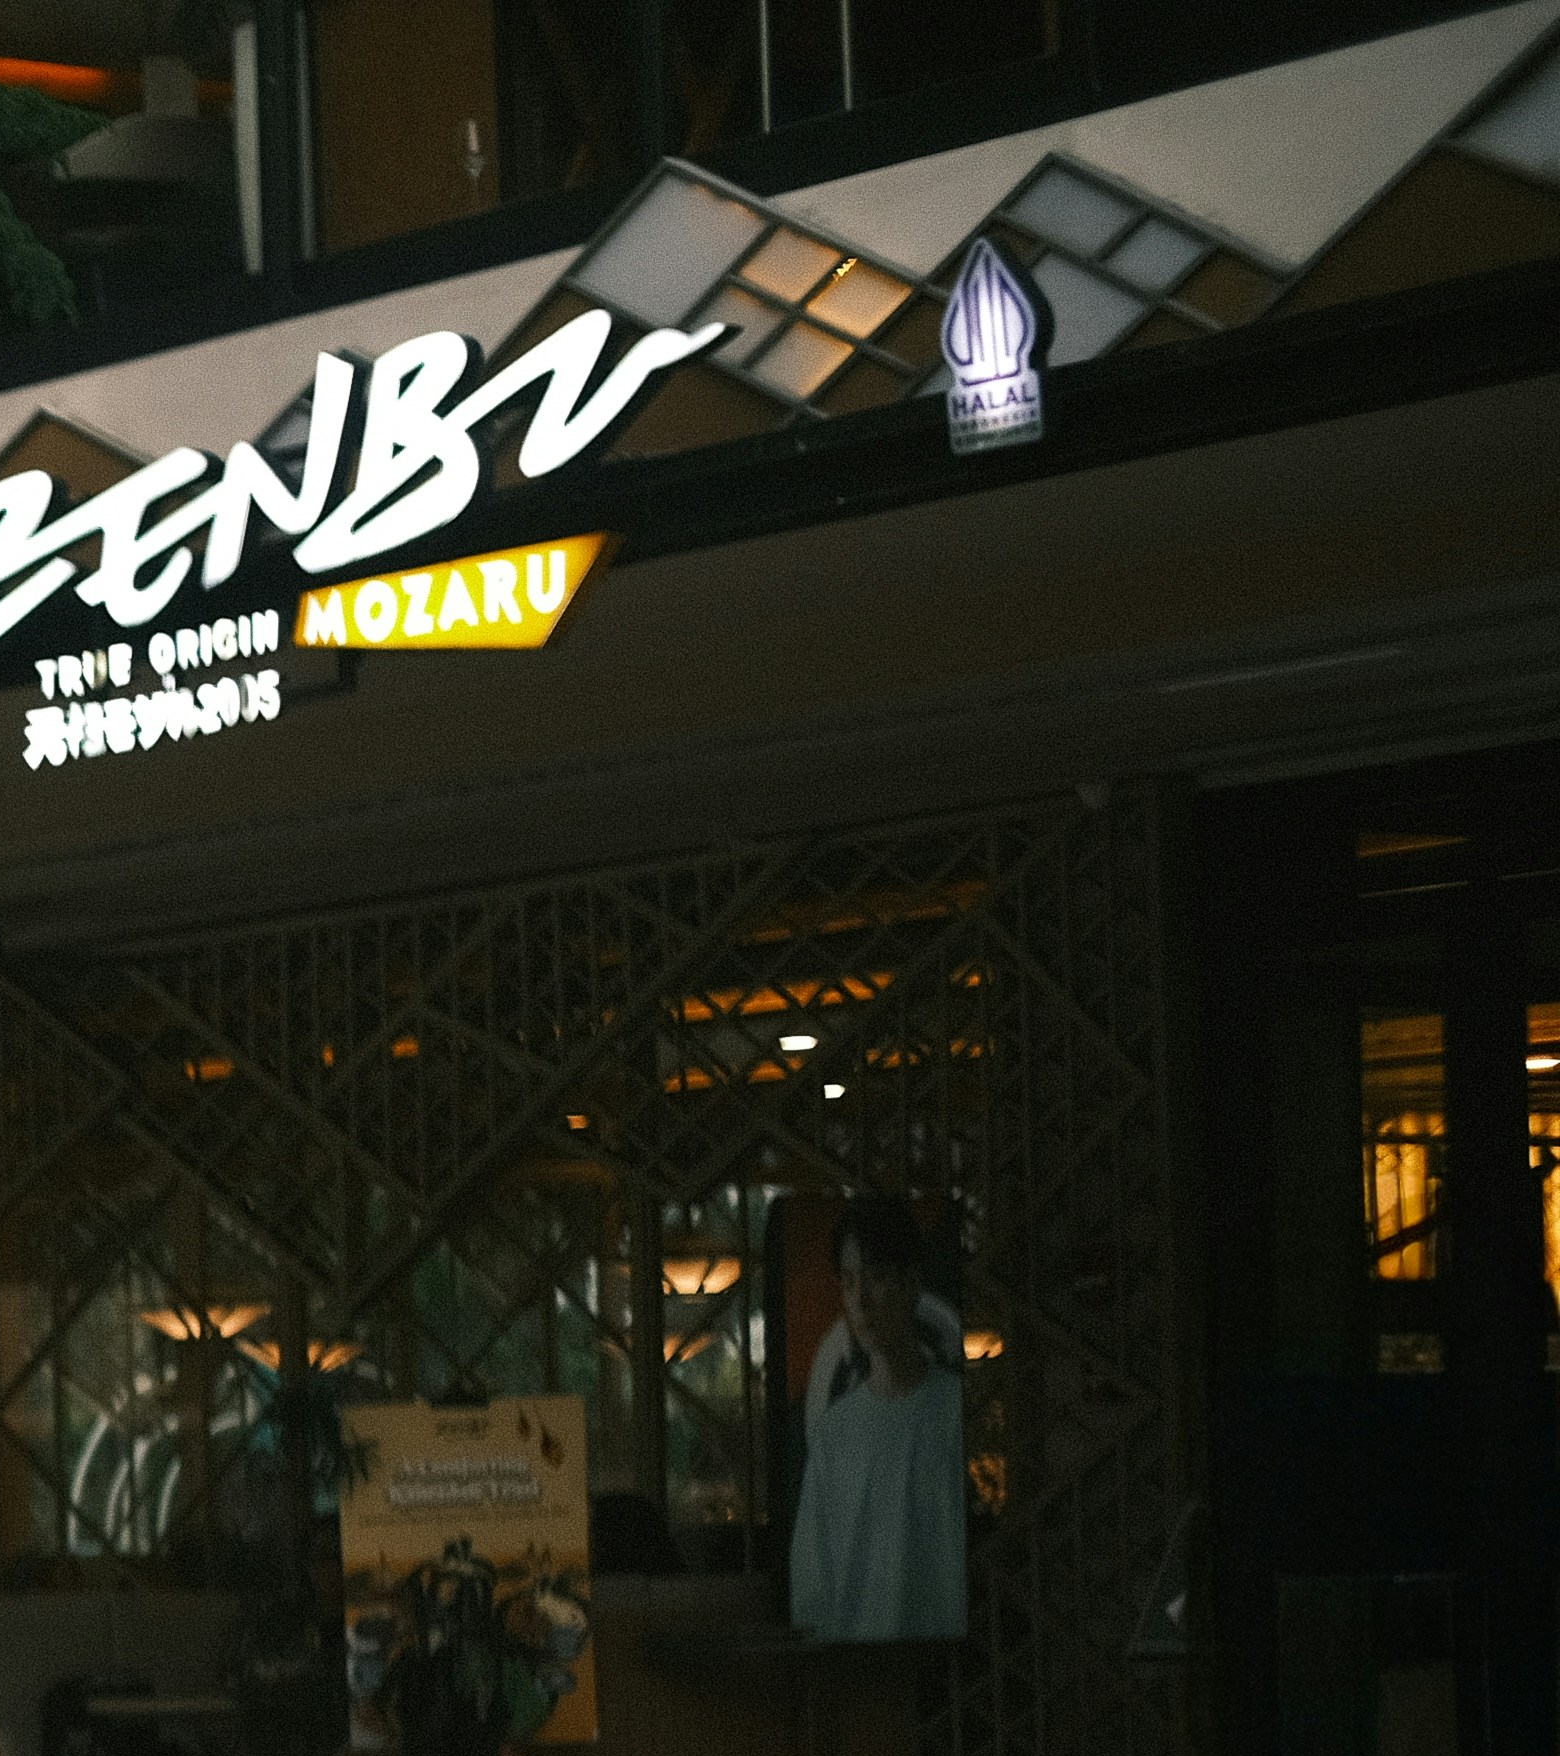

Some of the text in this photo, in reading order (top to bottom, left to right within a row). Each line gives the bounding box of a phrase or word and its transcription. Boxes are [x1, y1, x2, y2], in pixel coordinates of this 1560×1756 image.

[952, 383, 1036, 418] HALAL
[304, 550, 566, 645] MOZARU
[34, 608, 279, 700] TRUE ORIGIN
